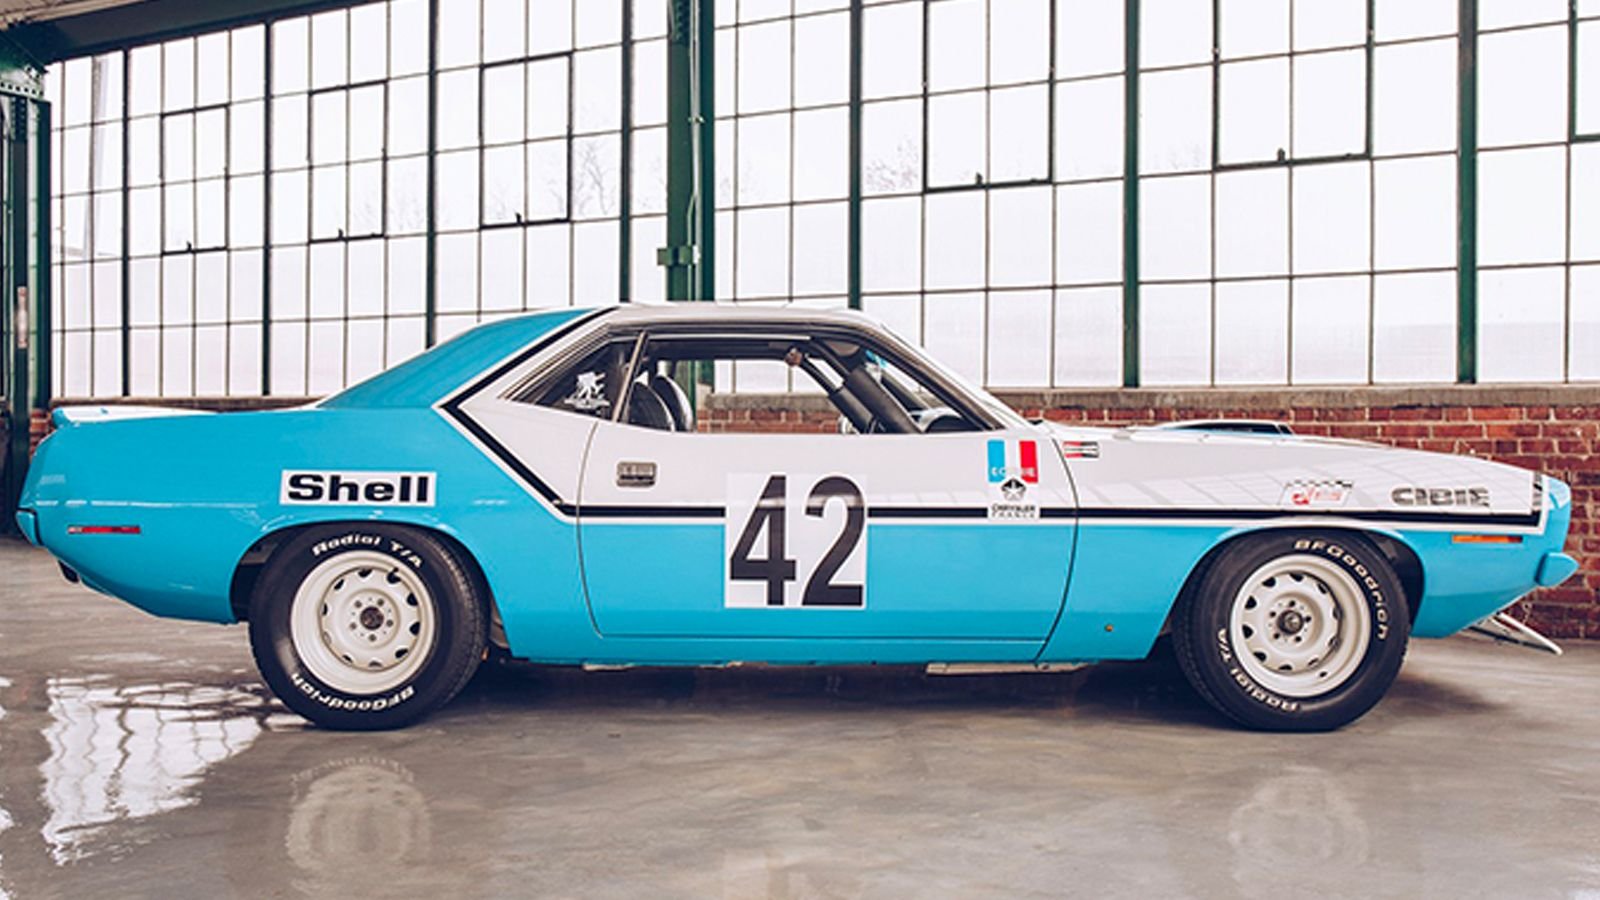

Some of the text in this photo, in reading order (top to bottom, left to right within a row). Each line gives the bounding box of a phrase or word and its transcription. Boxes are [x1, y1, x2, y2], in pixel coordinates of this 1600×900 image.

[287, 473, 430, 502] Shell
[1391, 487, 1490, 508] CIBIE
[312, 533, 423, 569] Radial T/A
[730, 475, 866, 607] 42
[1294, 539, 1390, 640] BFGoodrich
[291, 672, 416, 712] BFGoodrich
[1230, 667, 1299, 713] Radial
